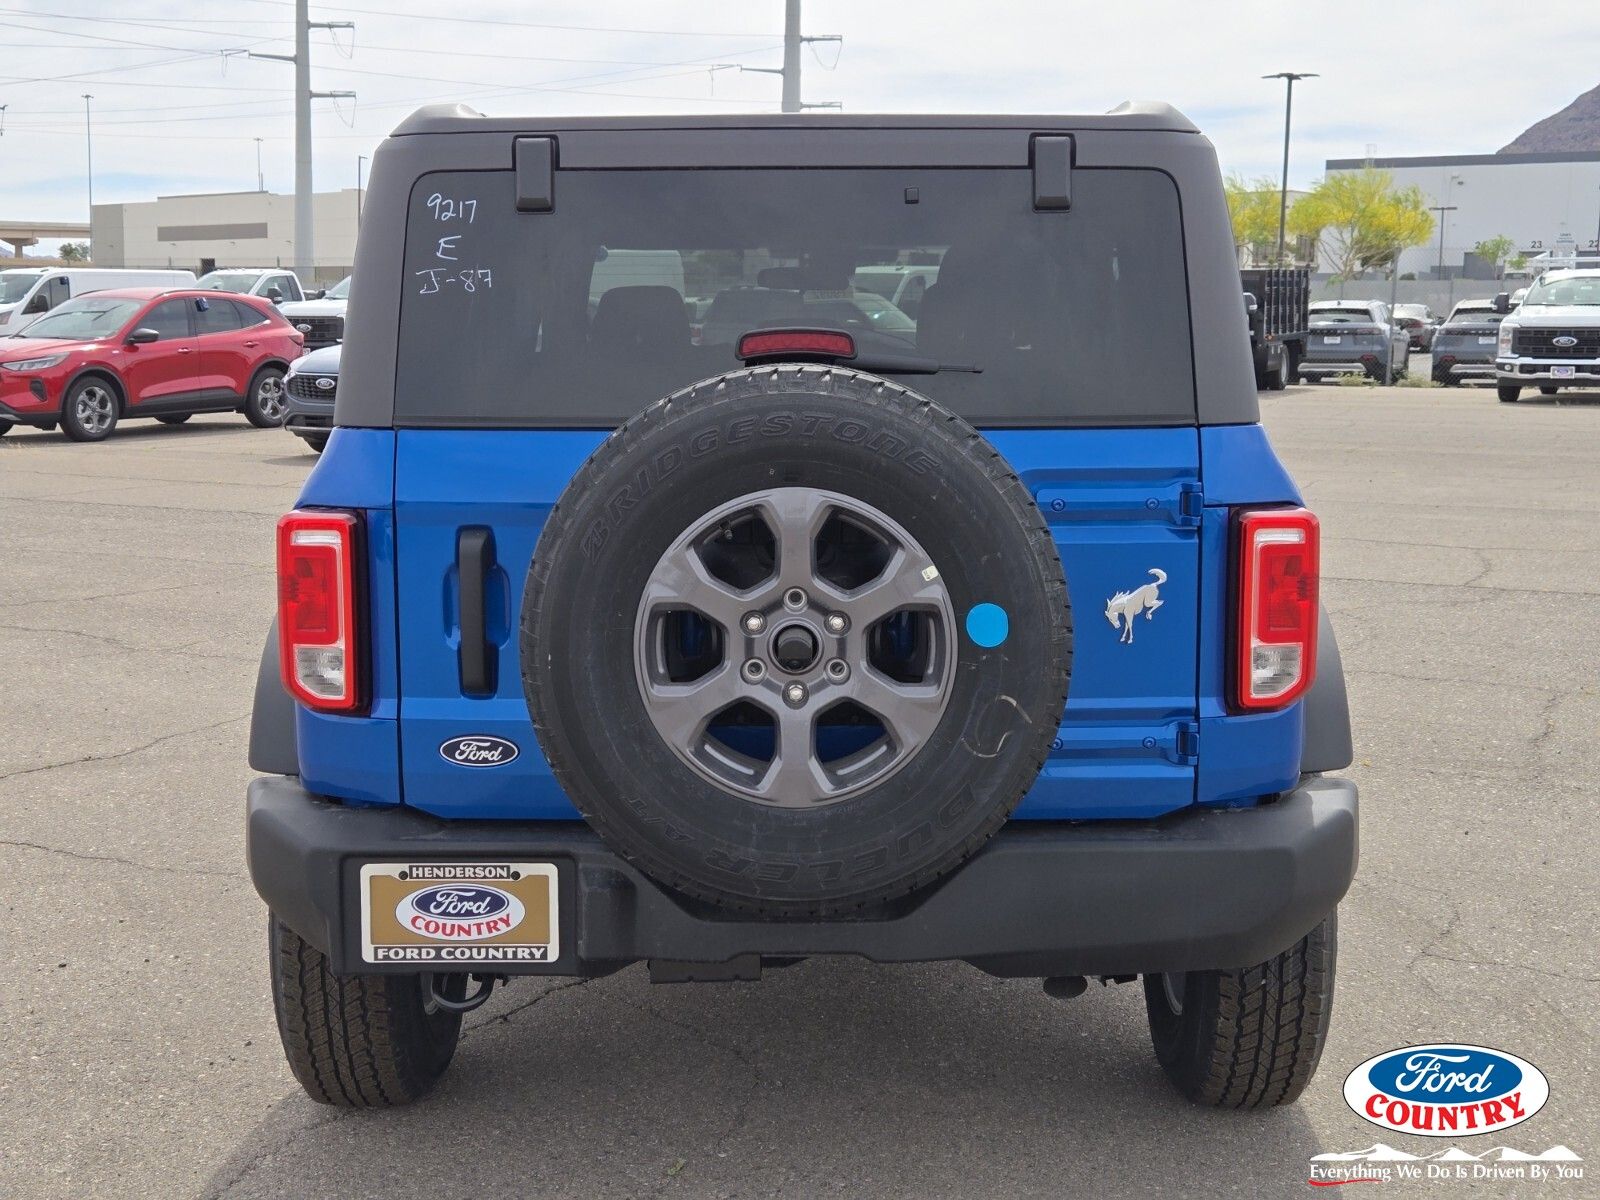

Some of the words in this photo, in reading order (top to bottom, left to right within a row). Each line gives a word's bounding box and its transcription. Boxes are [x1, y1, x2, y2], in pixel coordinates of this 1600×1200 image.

[427, 193, 477, 223] 9217
[436, 235, 461, 260] E
[1530, 240, 1543, 249] 23
[581, 411, 943, 565] BRIDGESTONE
[454, 740, 504, 762] Ford
[412, 866, 508, 879] HENDERSON
[429, 889, 491, 914] Ford
[410, 914, 512, 937] COUNTRY
[377, 947, 436, 960] FORD
[440, 947, 545, 960] COUNTRY
